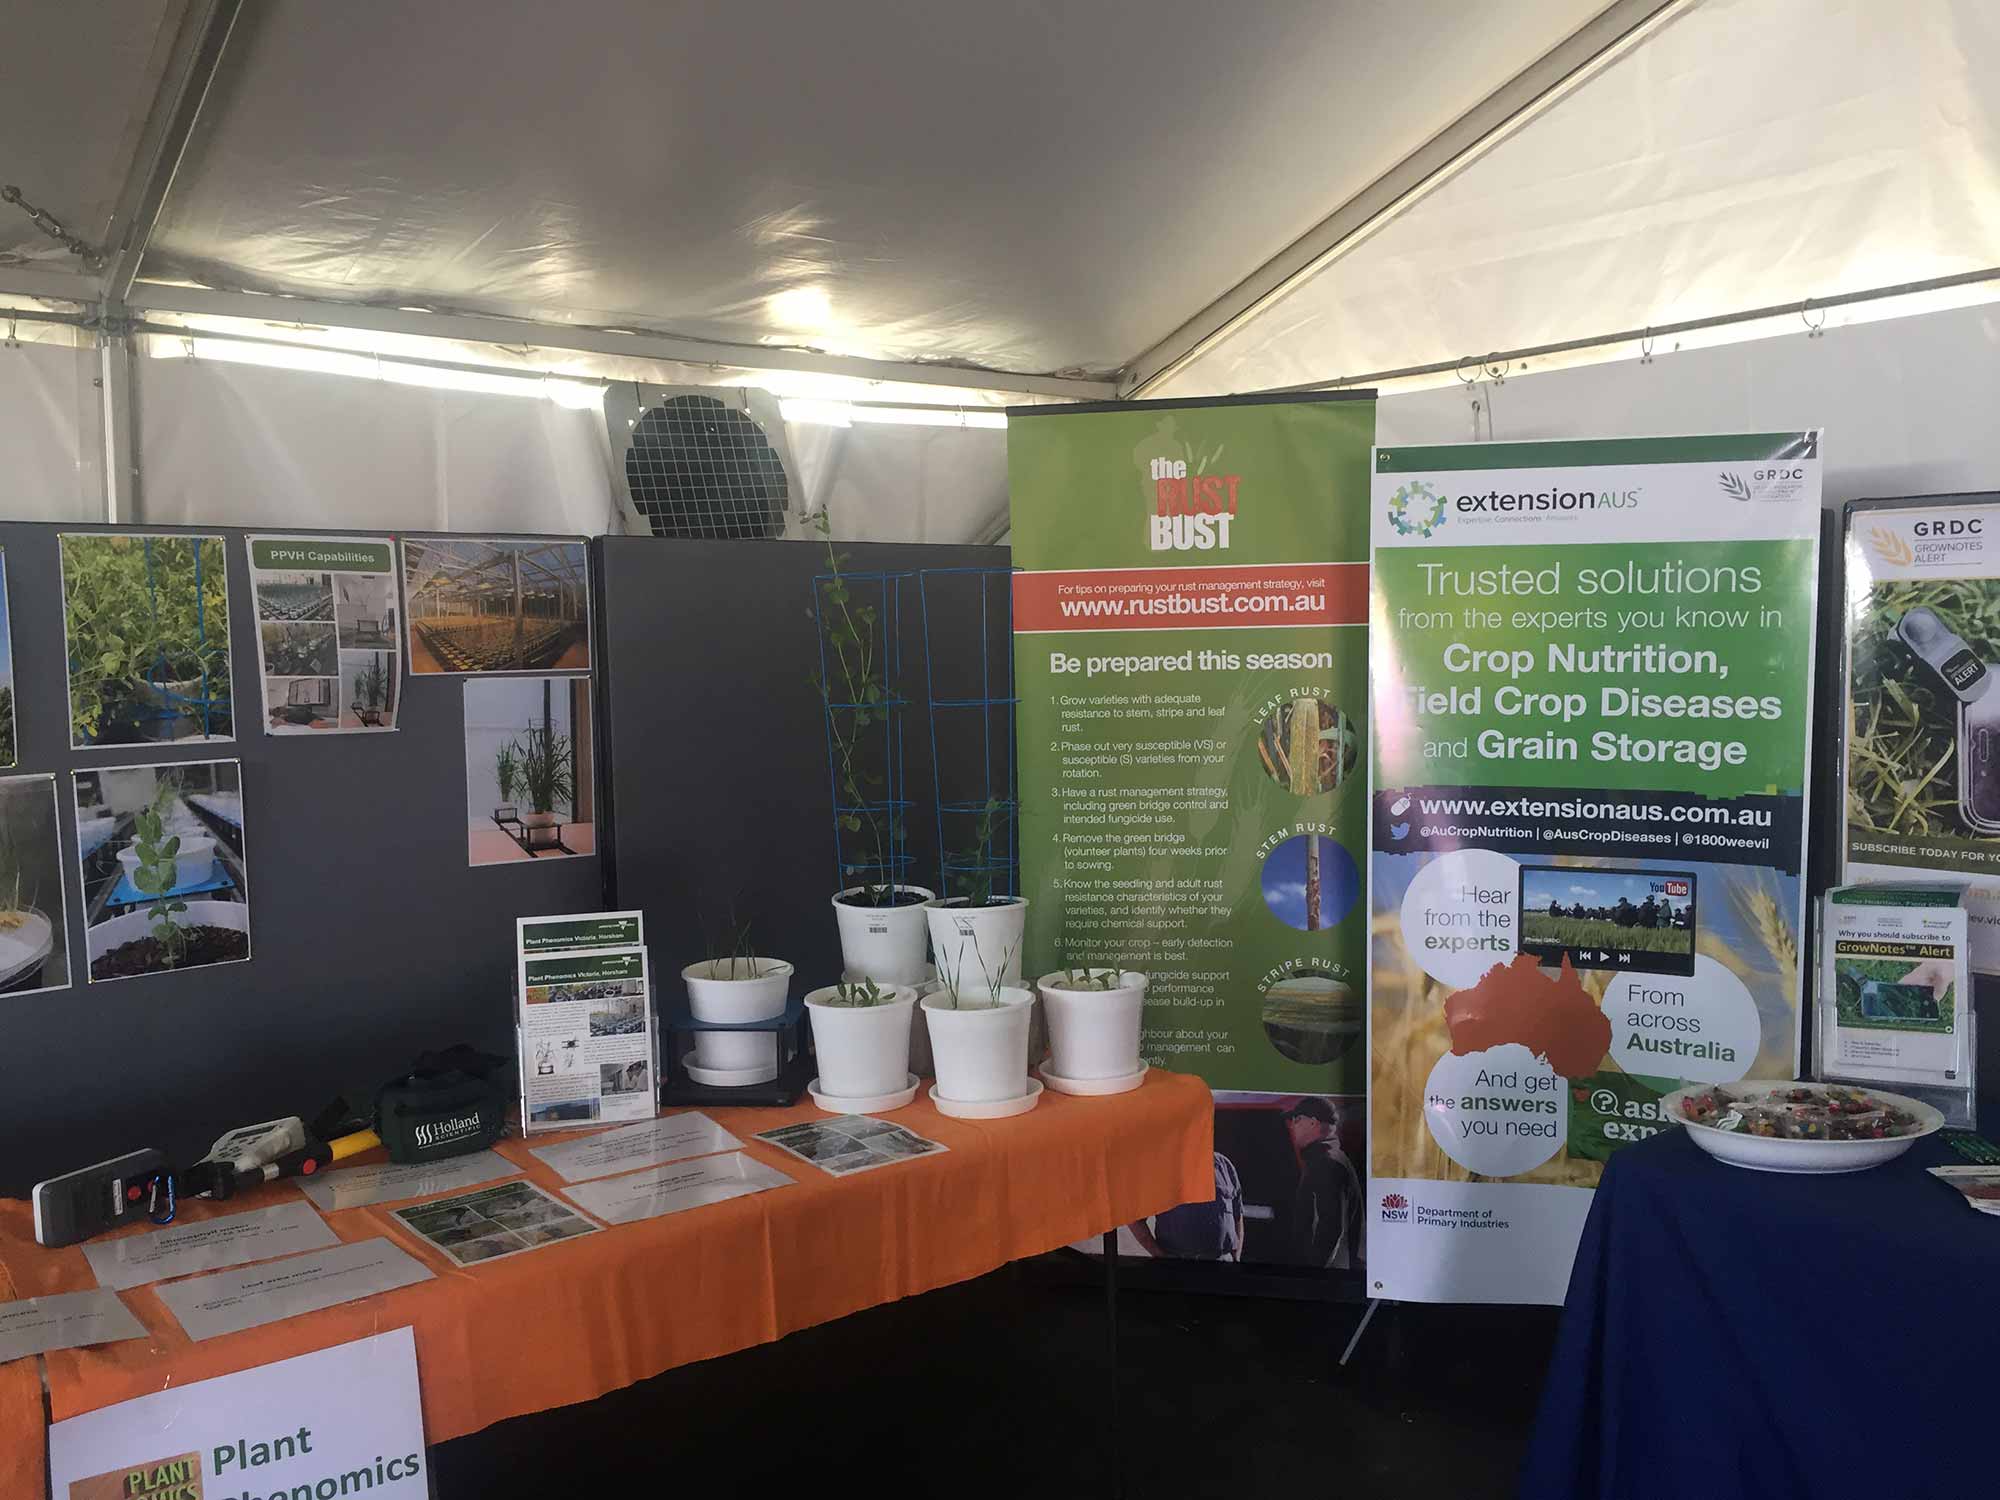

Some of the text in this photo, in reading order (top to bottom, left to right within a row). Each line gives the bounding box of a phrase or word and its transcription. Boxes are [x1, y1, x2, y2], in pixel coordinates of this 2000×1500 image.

[1151, 457, 1187, 480] the
[1754, 469, 1803, 481] GRDC
[1156, 475, 1241, 516] RUST
[1151, 513, 1235, 551] BUST
[1914, 519, 1983, 537] GRDC
[1915, 541, 1983, 553] GROWNOTES
[270, 549, 375, 564] PPVH Capabilities
[1914, 553, 1947, 562] ALERT
[1058, 577, 1326, 596] For tips on preparing your rust management strategy, visit
[1417, 560, 1762, 596] Trusted solutions
[1060, 593, 1326, 617] www.rustbust.com.au
[1398, 605, 1782, 633] from the experts you know in
[1050, 650, 1333, 677] Be prepared this season
[1443, 643, 1730, 679] Crop Nutrition,
[1954, 663, 1979, 686] ALERT
[1060, 694, 1201, 705] Grow varieties with adequate
[1253, 686, 1331, 725] LEAF RUST
[1405, 686, 1782, 722] ield Crop Diseases
[1061, 706, 1226, 719] resistance stripe and leaf
[1062, 723, 1083, 732] rust.
[1061, 739, 1214, 753] Phase out very susceptible (VS)
[1423, 729, 1748, 771] and Grain Storage
[1062, 753, 1225, 767] susceptible varieties from your
[1062, 768, 1102, 778] rotation.
[1062, 786, 1228, 798] Have rust management strategy,
[1064, 799, 1229, 812] including green bridge control and
[1420, 797, 1772, 827] www.extensionaus.com.au
[1064, 813, 1176, 825] intended fungicide use.
[1063, 832, 1185, 844] Remove green bridge
[1255, 823, 1337, 859] STEM RUST
[1420, 826, 1769, 849] @AuCropNutrition @AusCropDiseases @1800weevil
[1064, 846, 1228, 858] (volunteer plants) four weeks prior
[1852, 842, 1985, 861] SUBSCRIBE TODAY FOR
[1077, 860, 1114, 872] sowing.
[1064, 878, 1201, 890] Know seedling adult
[1065, 892, 1223, 903] resistance characteristics your
[1461, 885, 1511, 905] Hear
[1065, 905, 1232, 917] varieties, identify whether they
[1424, 908, 1511, 928] from the
[1065, 919, 1188, 930] require chemical support.
[1838, 930, 1856, 939] Why
[1873, 929, 1900, 939] should
[1902, 931, 1940, 940] subscribe
[1065, 938, 1233, 950] Monitor crop early detection
[1424, 935, 1511, 953] experts
[1919, 945, 1951, 957] Alert
[1087, 952, 1151, 962] management
[1191, 971, 1230, 982] support
[1257, 957, 1350, 993] STRIPE RUST
[1152, 984, 1215, 995] performance
[1628, 984, 1685, 1007] From
[1173, 997, 1213, 1008] build-up
[1627, 1012, 1701, 1033] across
[1626, 1032, 1736, 1063] Australia
[1475, 1069, 1558, 1093] And get
[1429, 1094, 1558, 1114] the answers
[433, 1112, 480, 1136] Holland
[434, 1124, 481, 1140] SCIENTIFIC
[1461, 1117, 1557, 1138] you need
[1381, 1209, 1409, 1220] NSW
[1417, 1206, 1493, 1218] Department of
[1417, 1216, 1510, 1229] Primary Industries
[213, 1426, 313, 1476] Plant
[128, 1457, 196, 1495] PLANT
[218, 1453, 420, 1500] henomics
